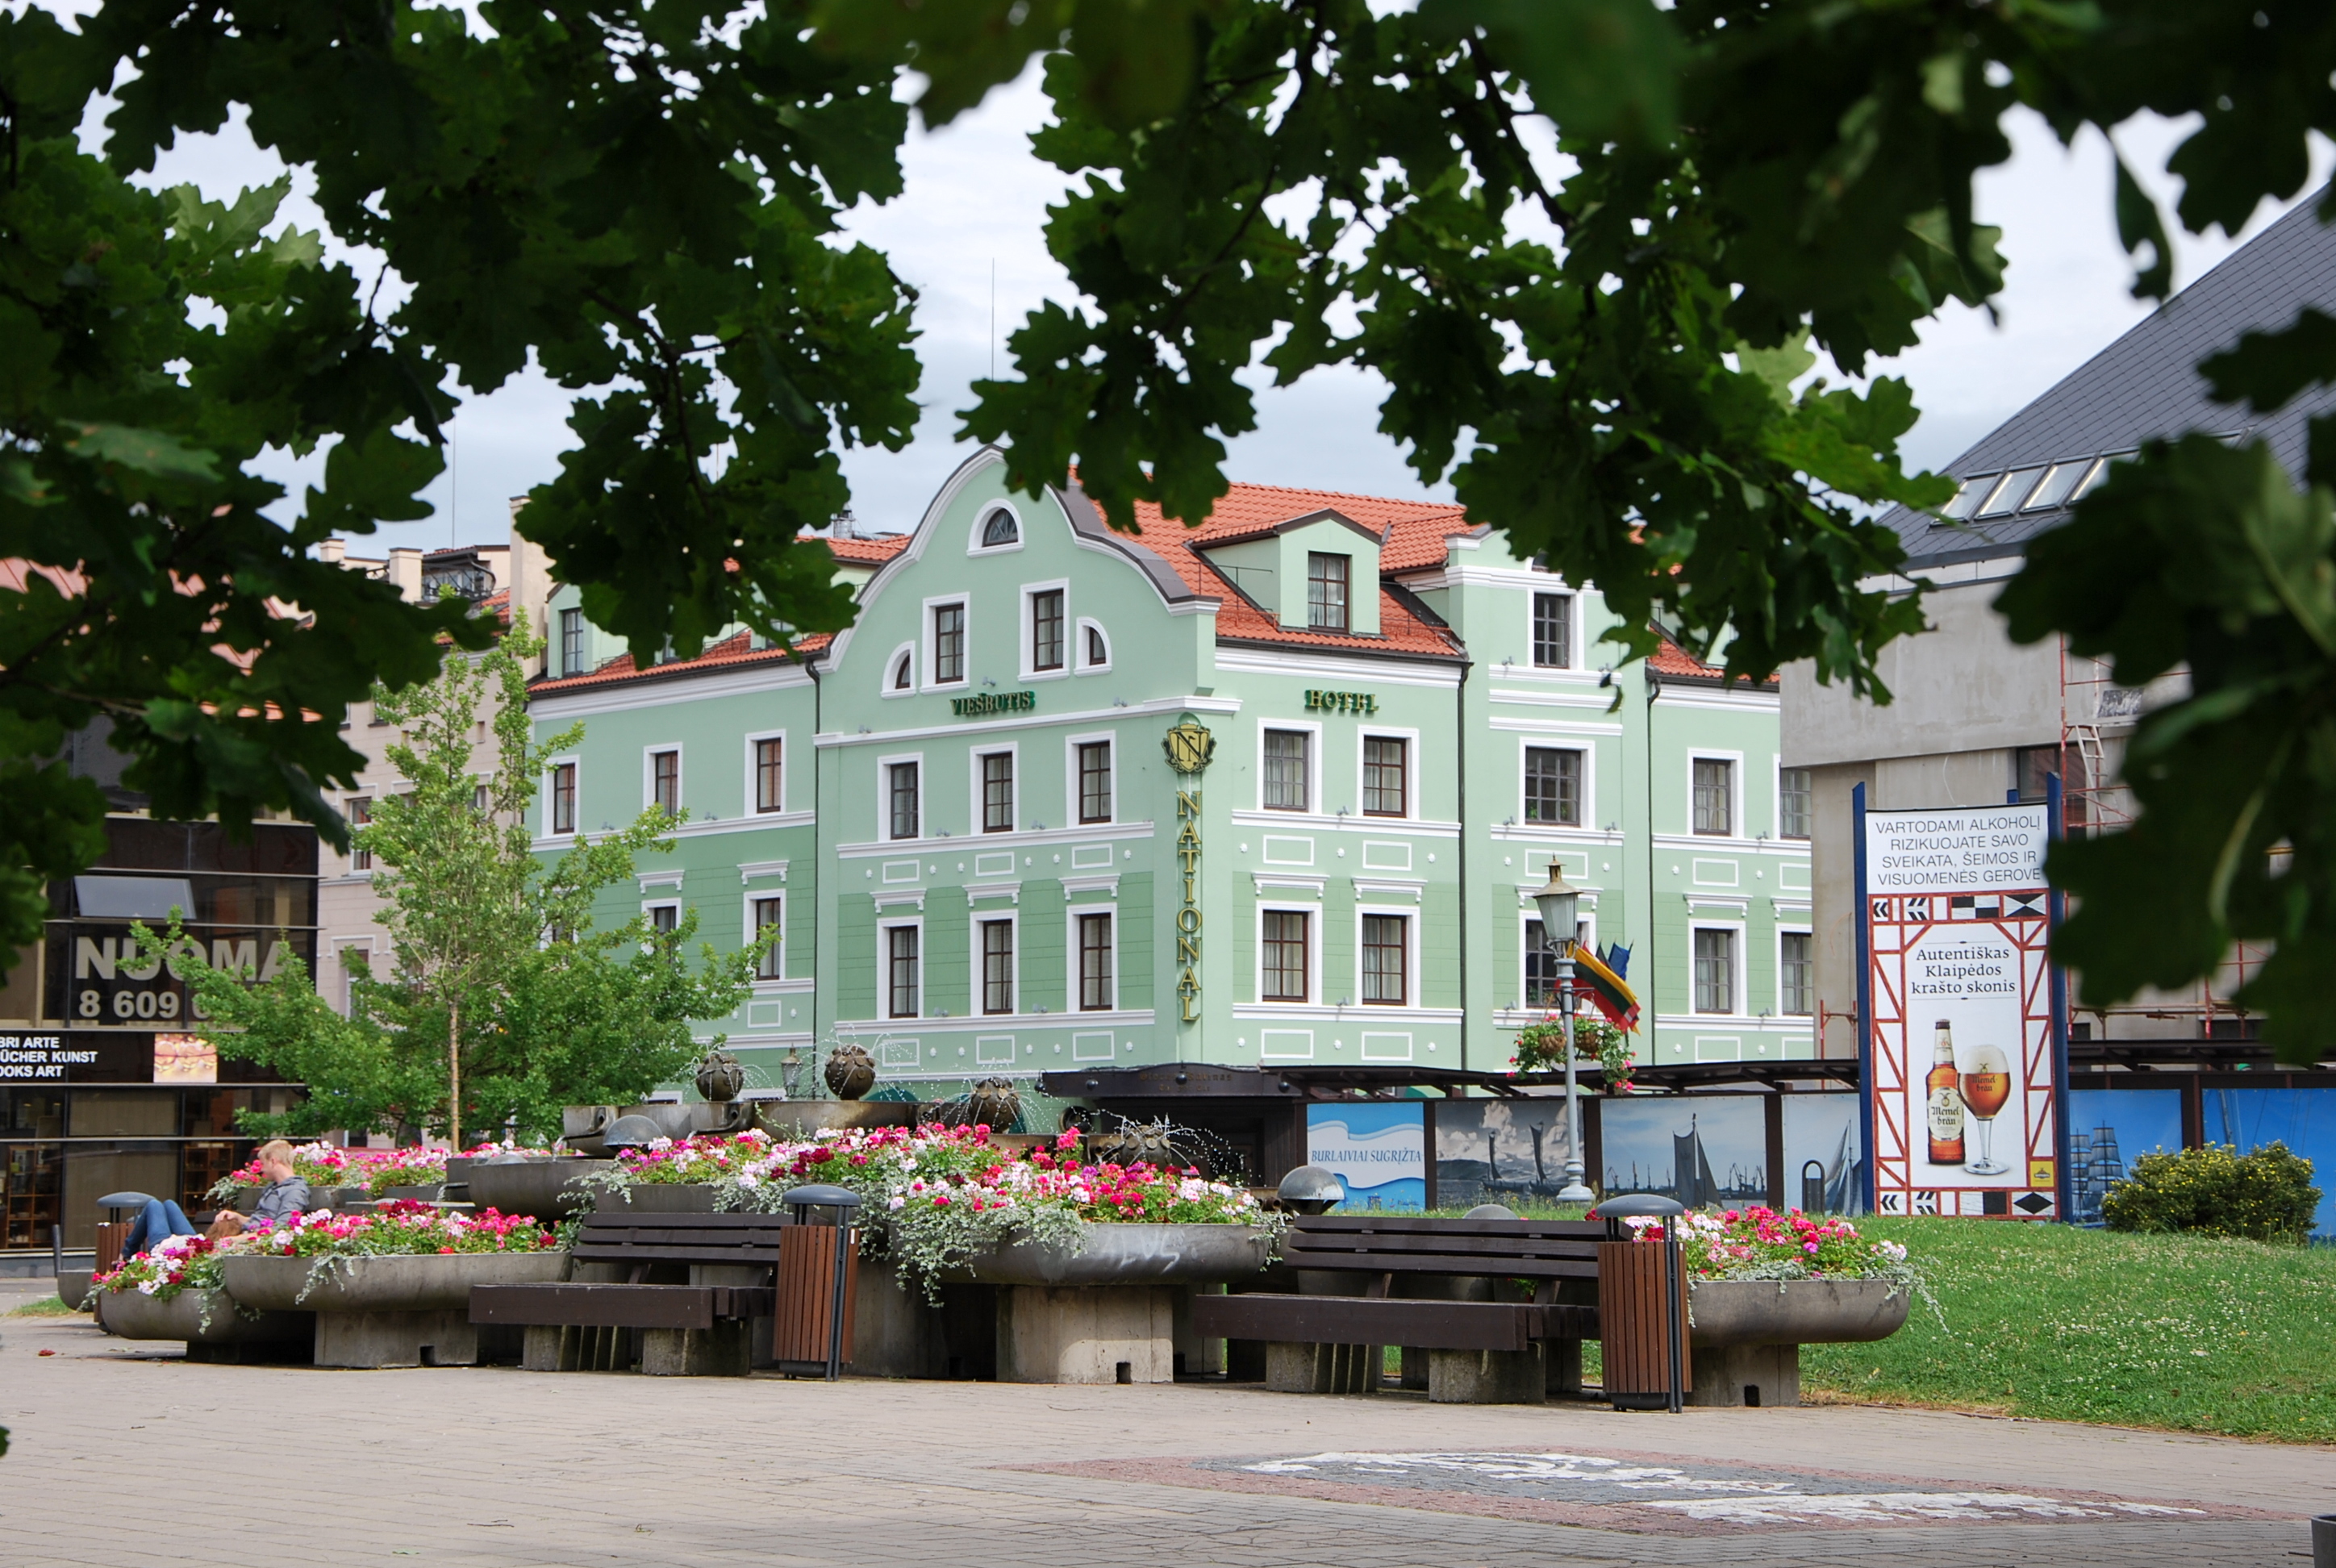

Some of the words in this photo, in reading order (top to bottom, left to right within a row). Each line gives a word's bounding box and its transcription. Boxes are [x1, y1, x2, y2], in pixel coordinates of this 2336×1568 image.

[949, 691, 1035, 715] VIEŠBUTIS
[1305, 690, 1379, 711] HOTEL
[1875, 819, 1964, 834] VARTODAMI
[1969, 815, 2040, 831] ALKOHOLĮ
[1891, 836, 1986, 851] RIZIKUOJATE
[1991, 833, 2029, 847] SAVO
[1882, 854, 1957, 869] SVEIKATA,
[1963, 851, 2018, 866] ŠEIMOS
[2024, 850, 2037, 863] IR
[1878, 869, 1978, 885] VISUOMENĖS
[1176, 790, 1203, 1022] NATIONAL
[1916, 946, 2010, 961] Autentiškas
[1925, 963, 2002, 979] Klaipėdos
[1912, 981, 1962, 995] krašto
[1967, 979, 2016, 993] skonis
[79, 990, 101, 1018] 8
[113, 990, 180, 1019] 609
[23, 1036, 60, 1049] ARTE
[52, 1051, 98, 1063] KUNST
[35, 1065, 64, 1077] ART
[1312, 1149, 1368, 1162] BURLAIVIAI
[1370, 1147, 1421, 1165] SUGRĮŽTA
